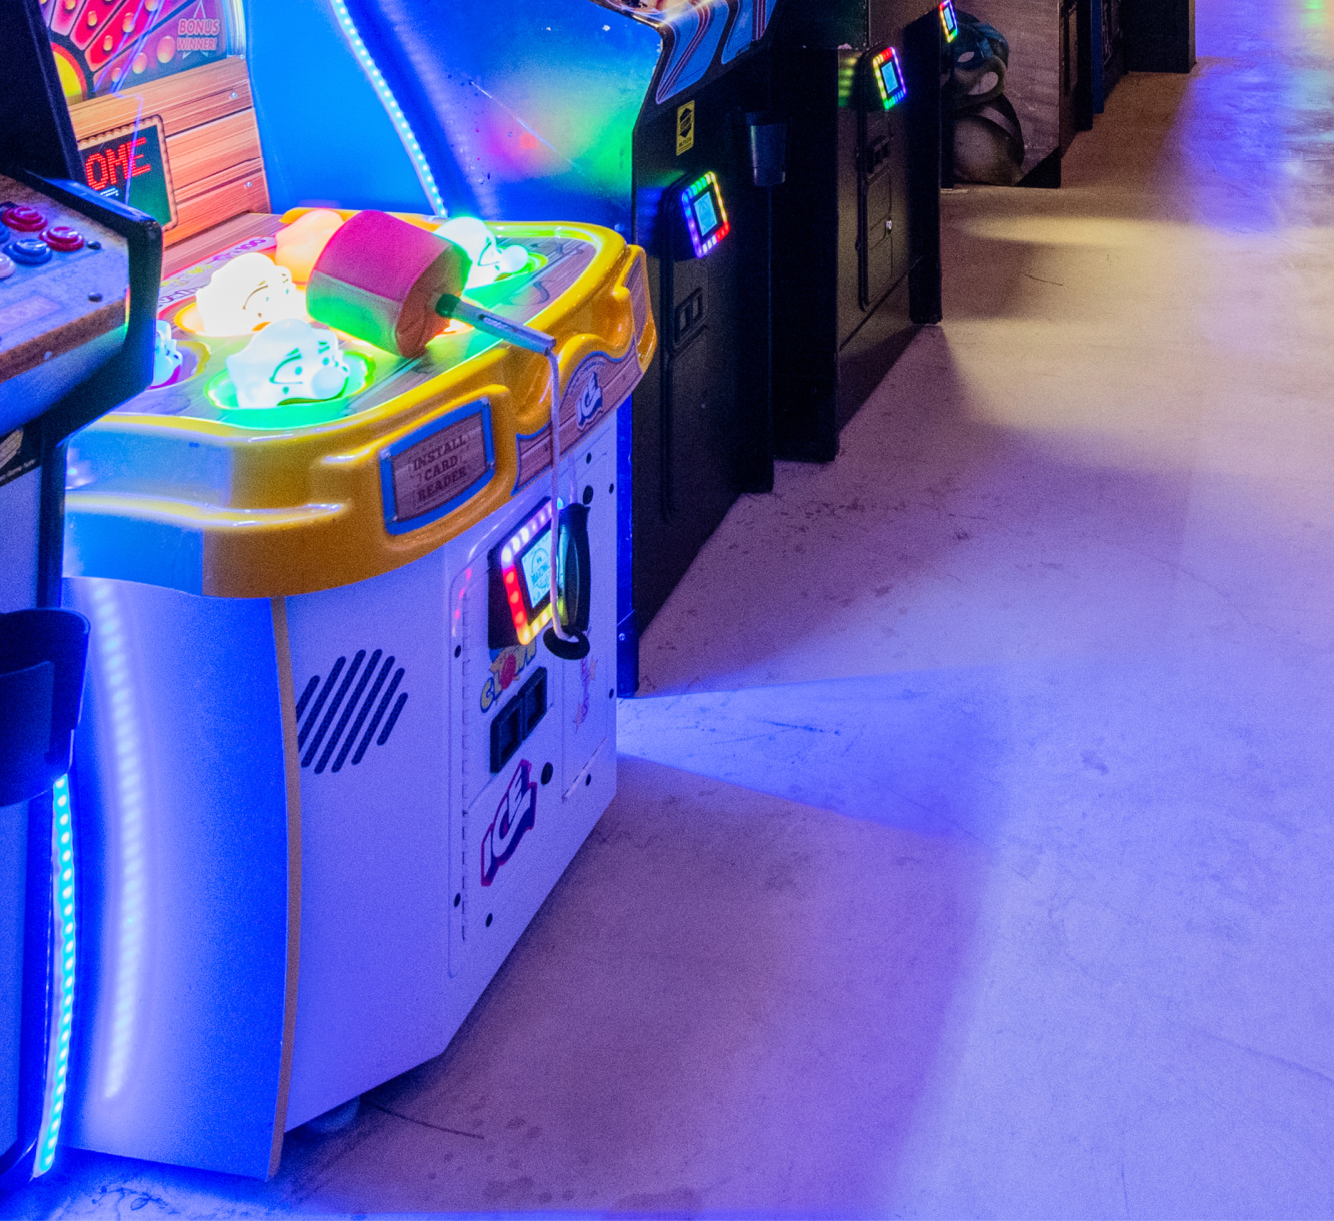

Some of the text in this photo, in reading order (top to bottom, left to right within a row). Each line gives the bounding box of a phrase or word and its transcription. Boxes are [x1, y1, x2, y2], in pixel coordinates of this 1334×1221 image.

[178, 18, 220, 35] BONUS
[175, 37, 218, 52] WINNER!
[576, 371, 603, 426] ICE
[424, 455, 458, 481] CARD
[418, 466, 467, 502] READER
[481, 758, 538, 887] ICE
